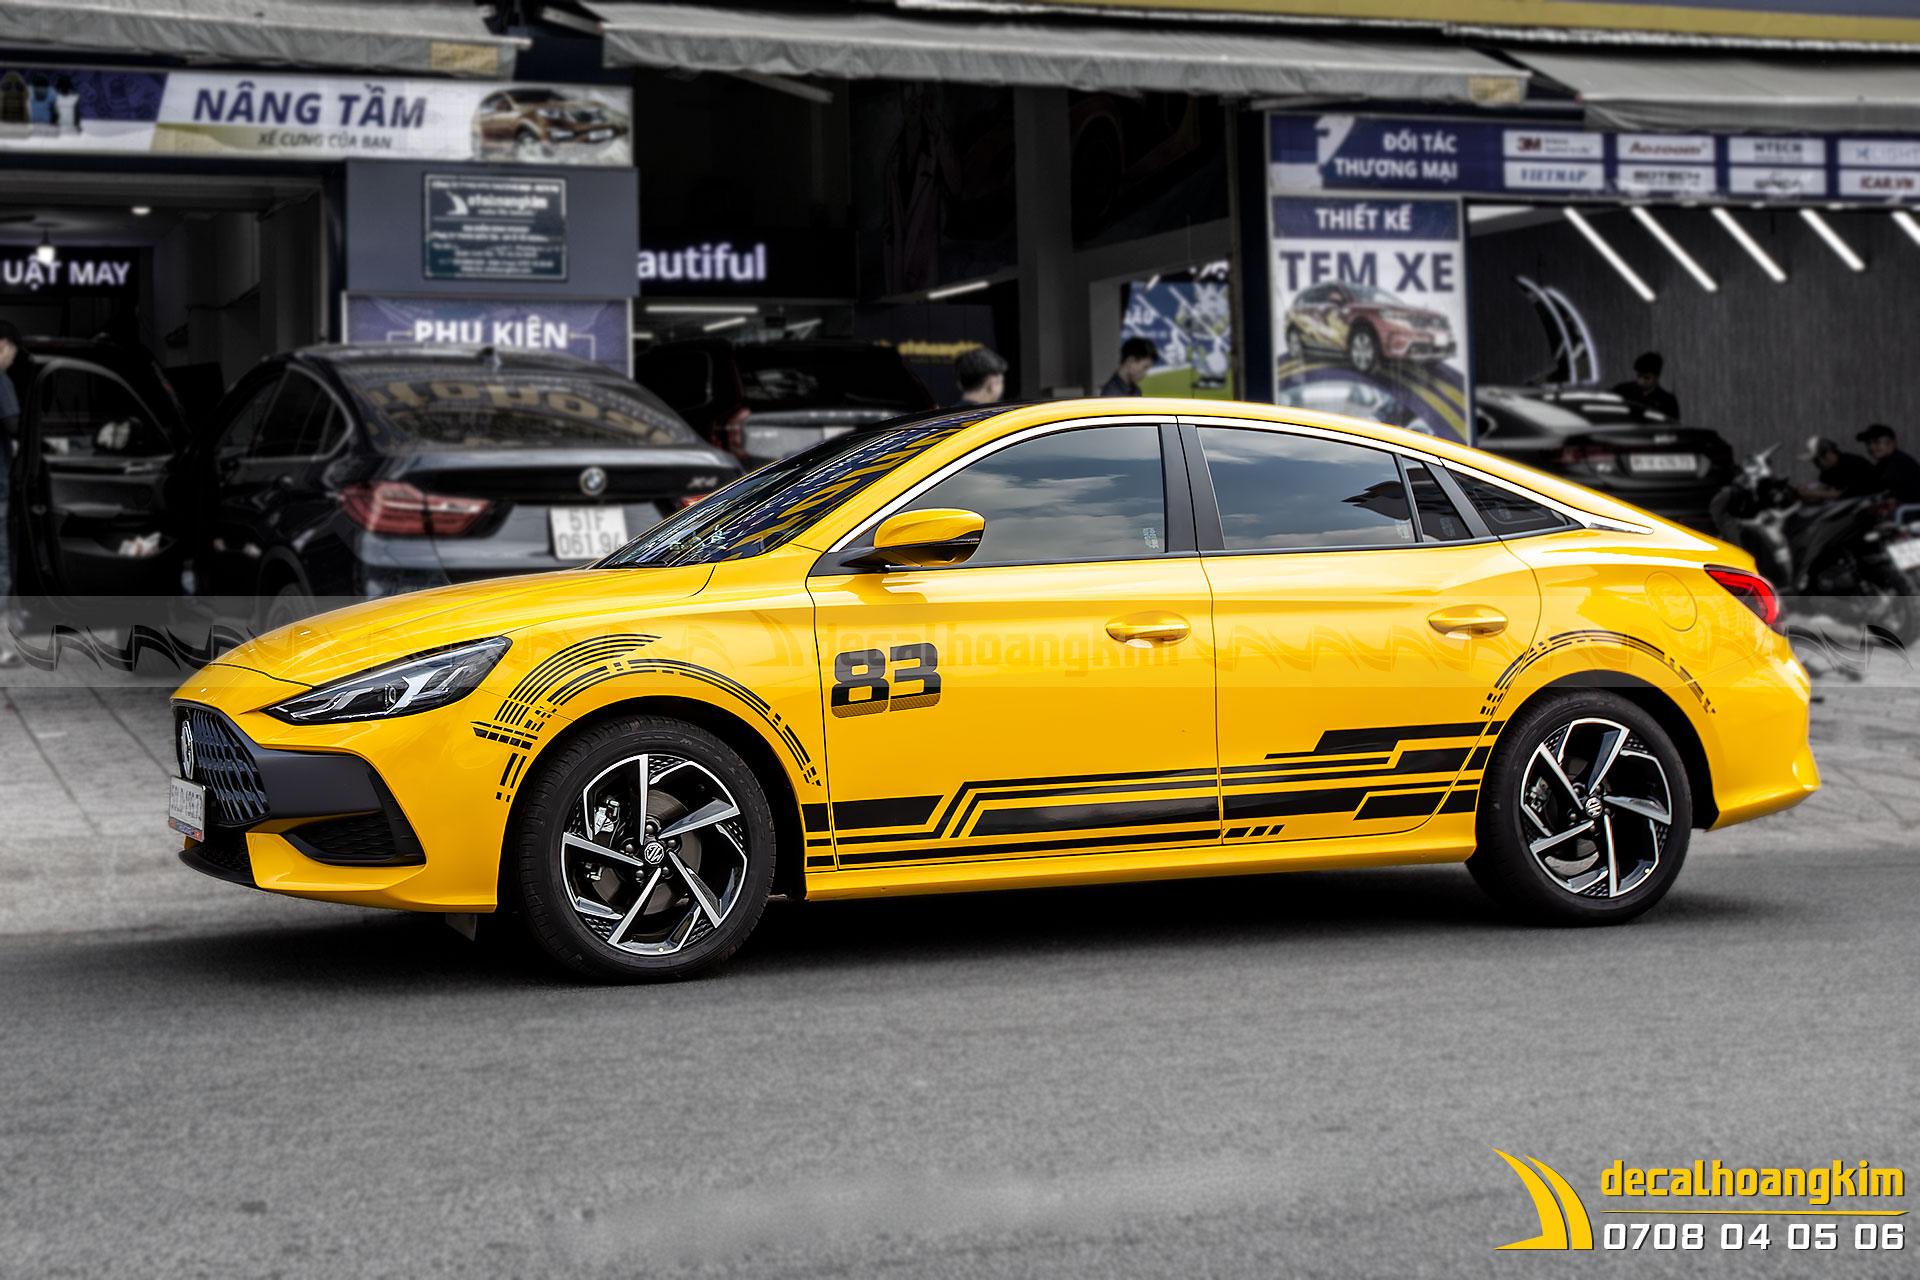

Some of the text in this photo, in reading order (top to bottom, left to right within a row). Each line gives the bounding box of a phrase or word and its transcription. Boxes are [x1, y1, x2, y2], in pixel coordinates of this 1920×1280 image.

[193, 80, 428, 128] NÂNG TẦM
[1382, 130, 1457, 153] ĐỐI TÁC
[1517, 136, 1542, 152] 3M
[1333, 158, 1458, 182] THƯƠNG MẠI
[1315, 203, 1413, 231] THIẾT KẾ
[69, 261, 130, 286] MAY
[1279, 250, 1455, 293] TEM XE
[569, 507, 606, 531] 51F
[830, 642, 942, 719] 83
